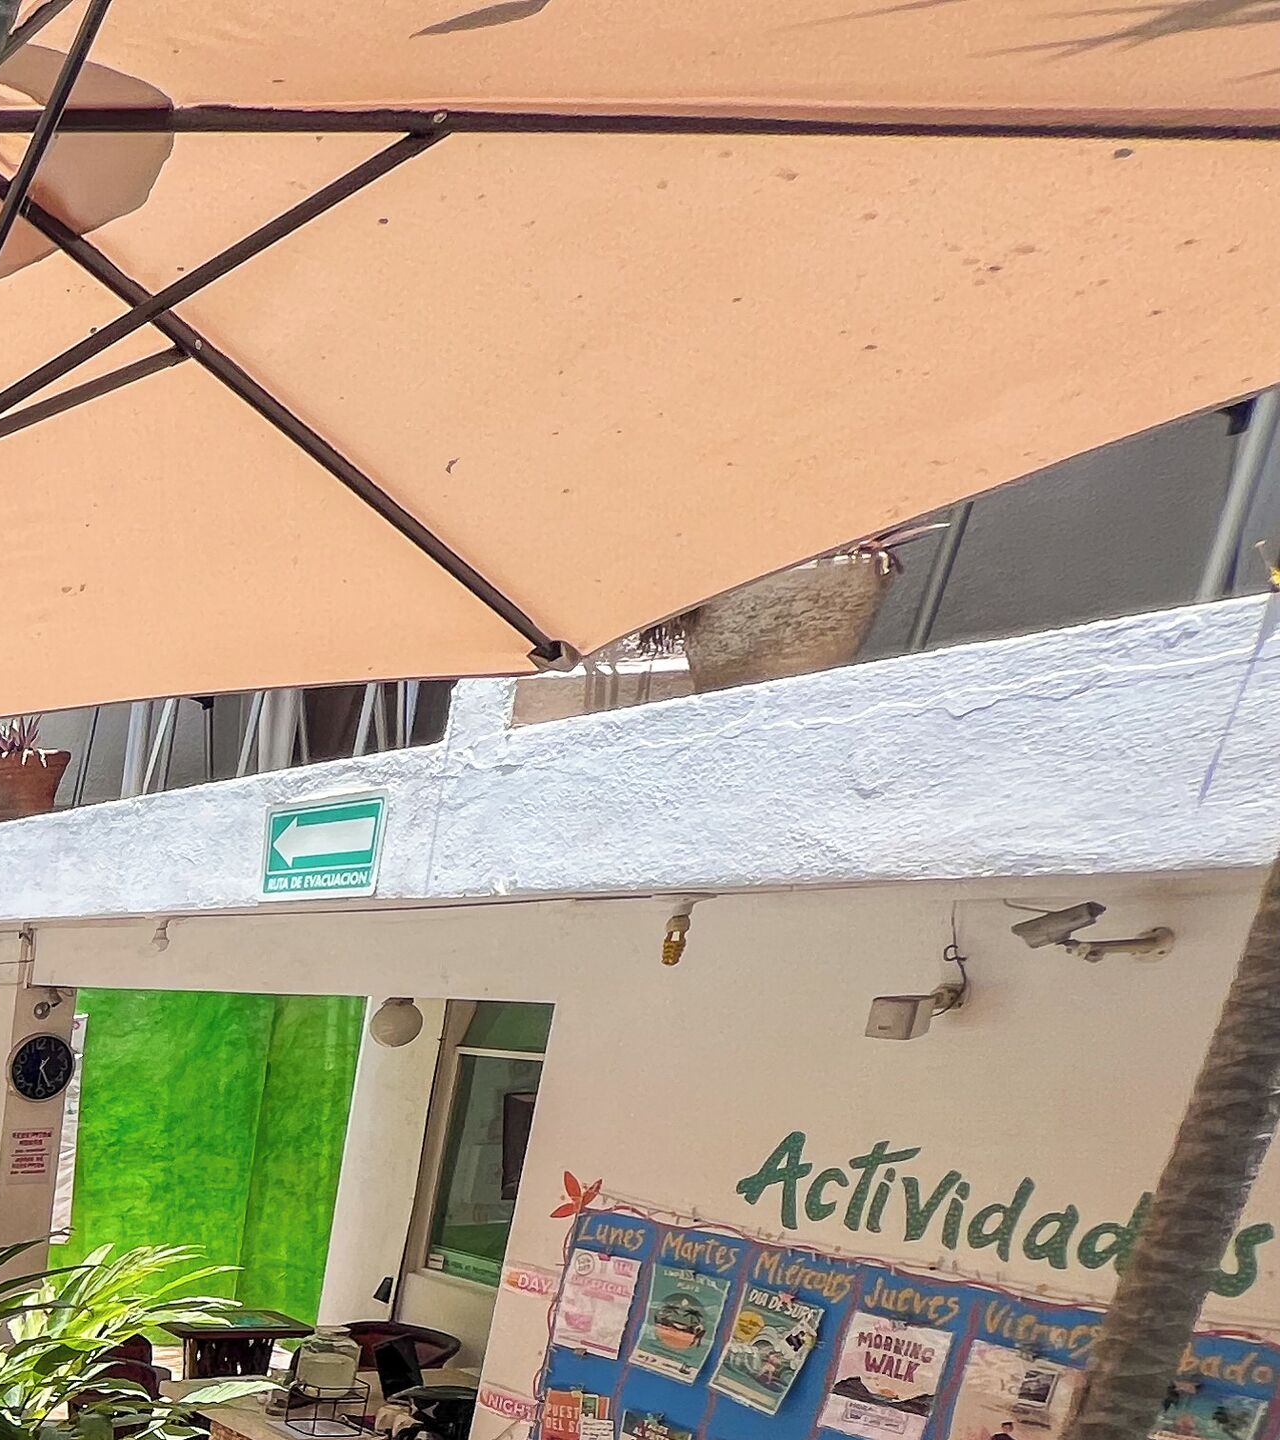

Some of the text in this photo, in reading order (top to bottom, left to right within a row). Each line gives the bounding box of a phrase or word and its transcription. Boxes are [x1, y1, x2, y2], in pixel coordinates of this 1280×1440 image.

[267, 871, 369, 890] RUTA DE EVACUACION
[736, 1130, 1276, 1298] Actividads
[577, 1215, 646, 1251] Lunes
[659, 1231, 740, 1273] Martes
[517, 1272, 552, 1295] DAY
[748, 1289, 769, 1307] DIA
[768, 1296, 784, 1312] DE
[864, 1275, 960, 1326] Jueves
[857, 1331, 936, 1364] MORNING
[864, 1352, 921, 1384] WALK
[1177, 1342, 1274, 1386] bado
[488, 1394, 537, 1421] NIGHT
[547, 1403, 579, 1419] PUEST
[545, 1418, 564, 1432] DEL
